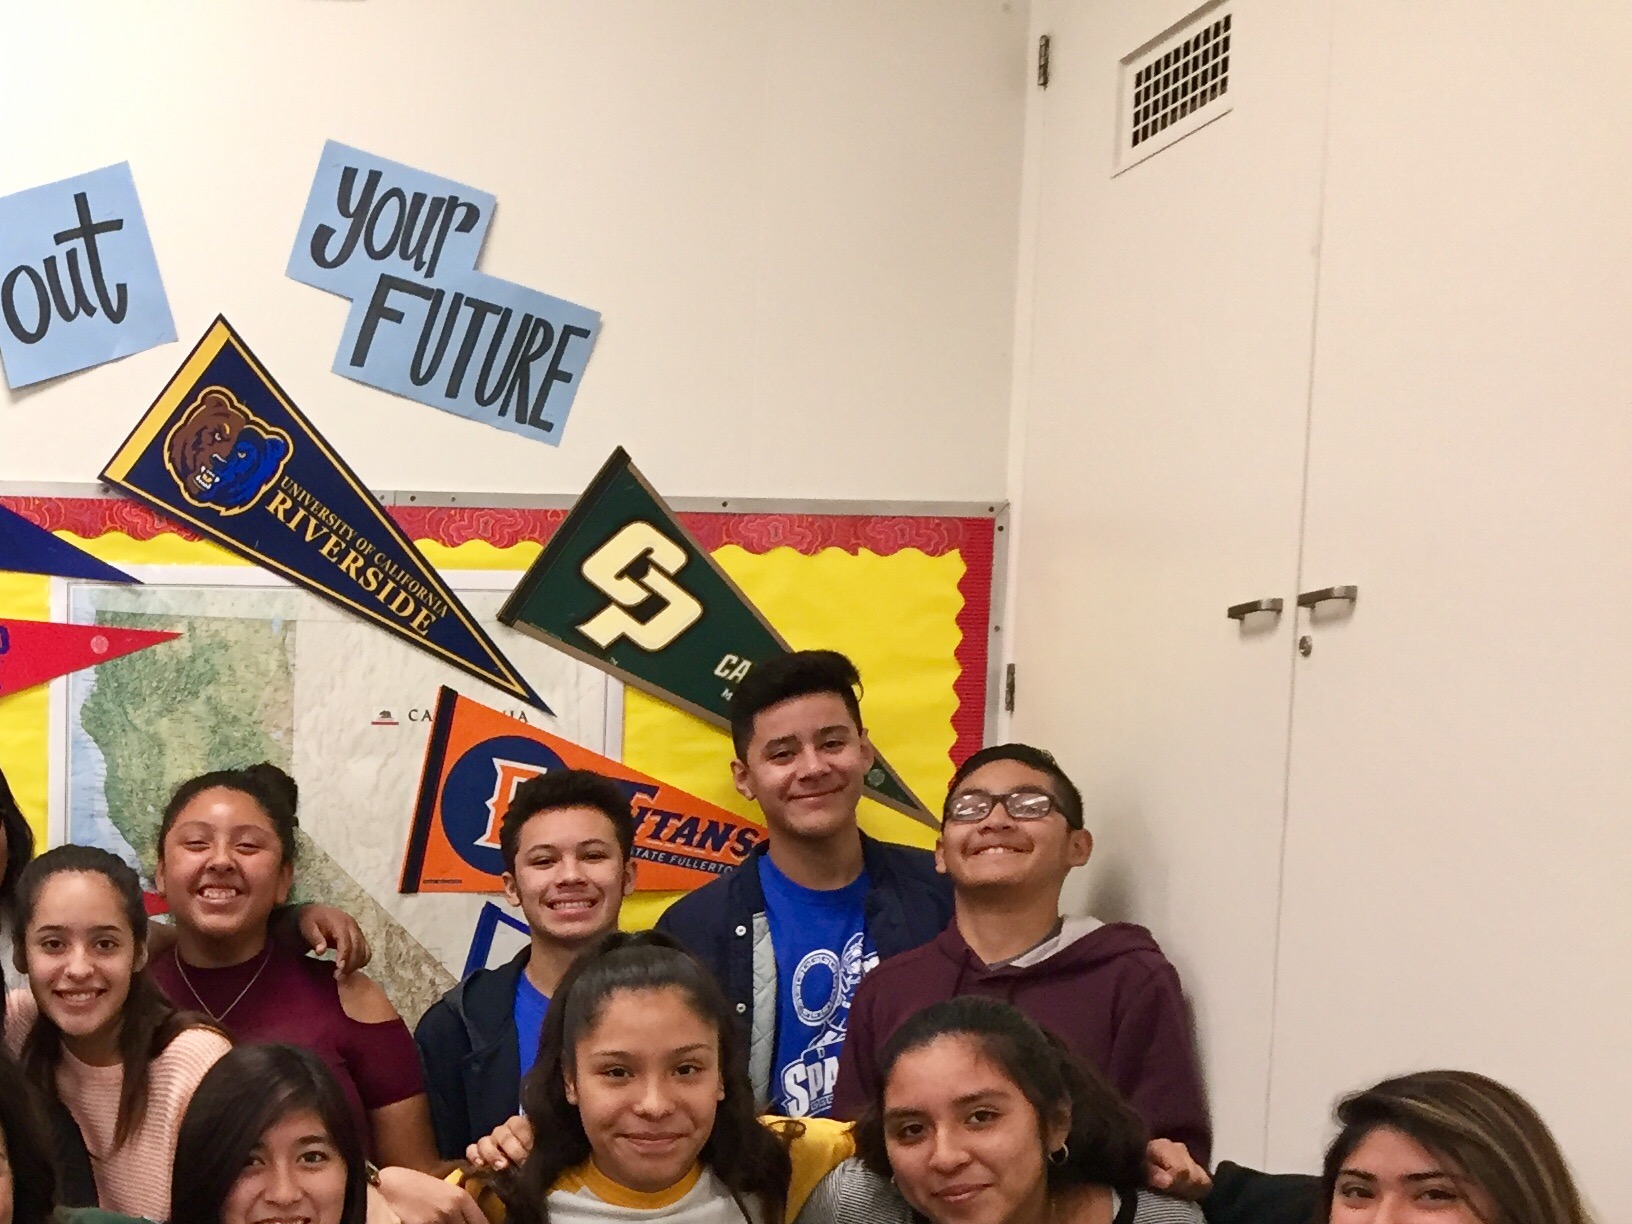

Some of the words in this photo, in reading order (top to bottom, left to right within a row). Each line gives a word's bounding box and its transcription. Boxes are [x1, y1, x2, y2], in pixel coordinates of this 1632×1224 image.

[0, 192, 128, 344] out
[310, 165, 481, 280] your
[350, 274, 591, 432] FUTURE
[265, 489, 437, 637] RIVERSIDE
[280, 475, 357, 543] UNIVERSITY
[355, 536, 375, 556] OF
[373, 551, 450, 619] CALIFORNIA
[713, 653, 753, 684] CA
[630, 847, 668, 862] TATE
[669, 855, 734, 875] FULLERTO
